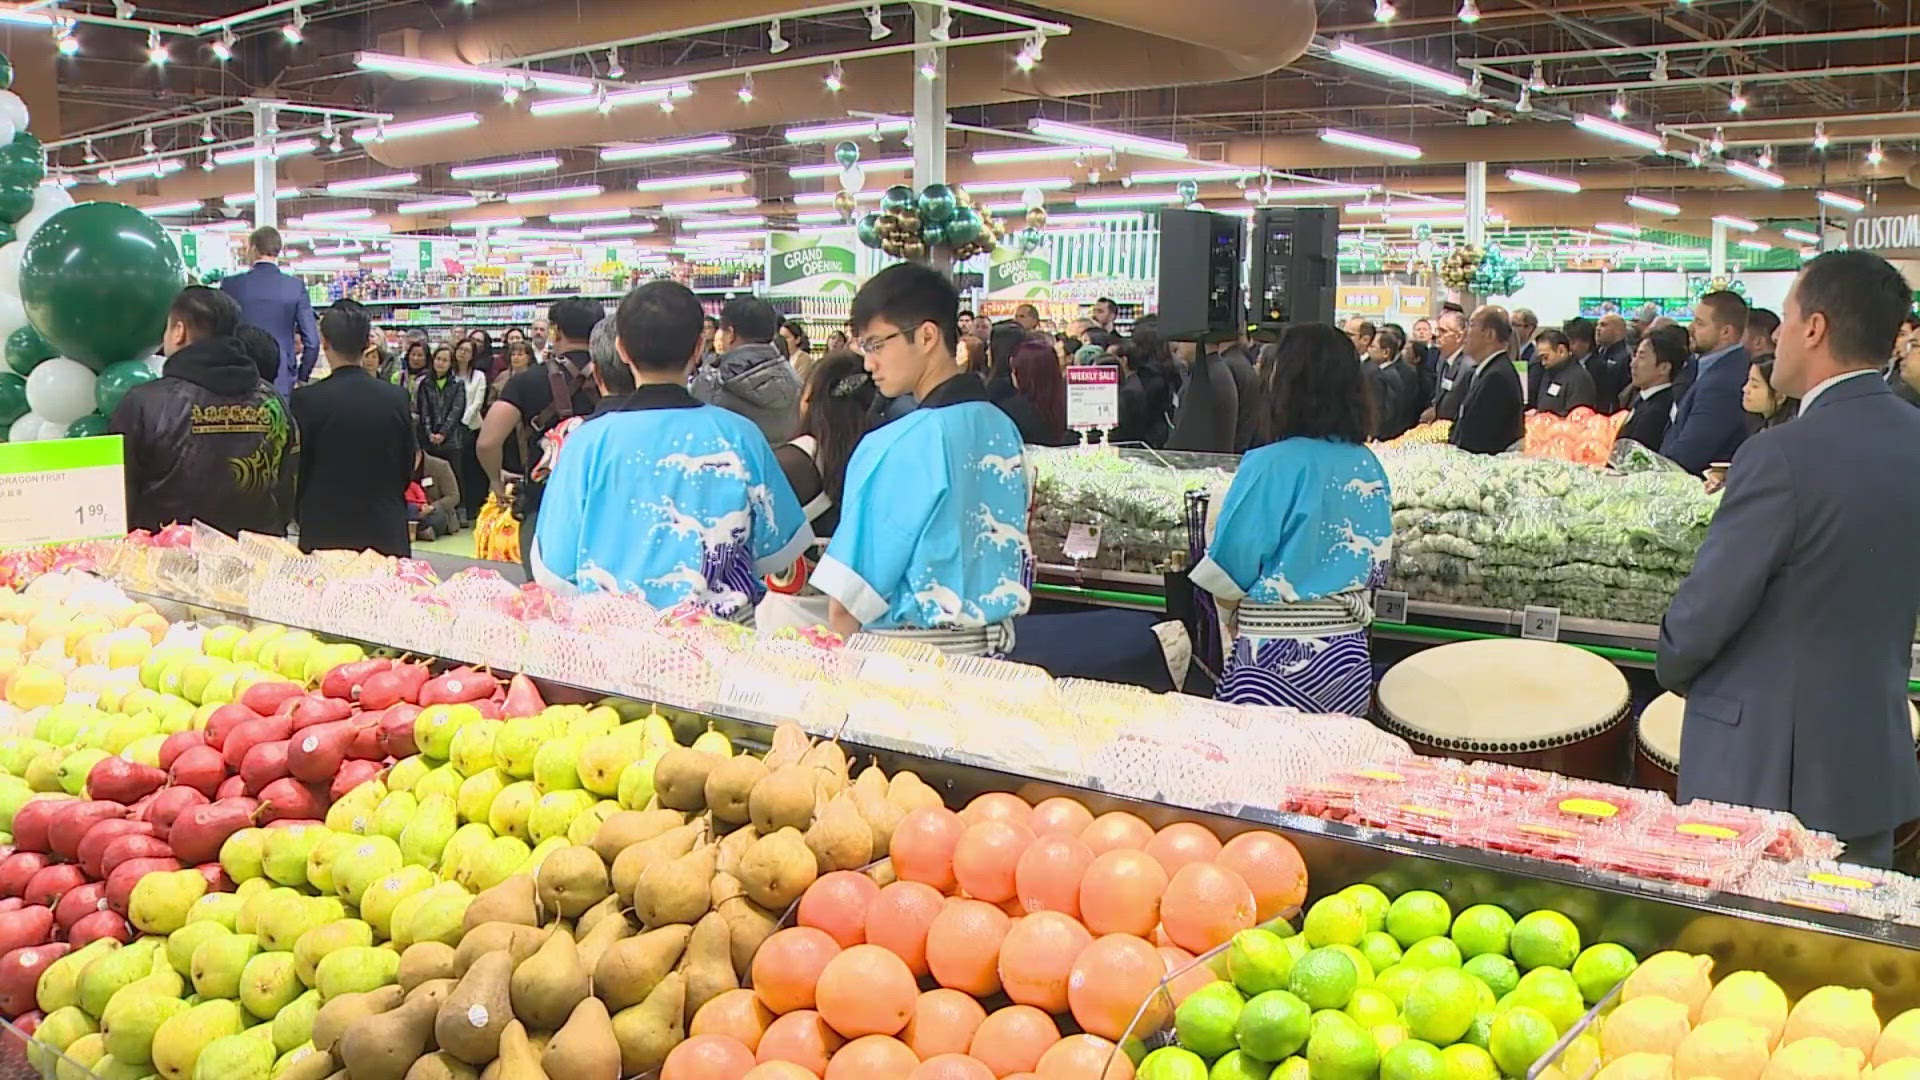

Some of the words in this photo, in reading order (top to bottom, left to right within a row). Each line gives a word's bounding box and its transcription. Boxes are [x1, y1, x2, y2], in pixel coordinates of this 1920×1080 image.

[1854, 214, 1919, 249] CUSTOM
[784, 248, 823, 270] GRAND
[802, 260, 844, 276] OPENING
[1070, 371, 1098, 381] WEEKLY
[1098, 370, 1116, 381] SALE
